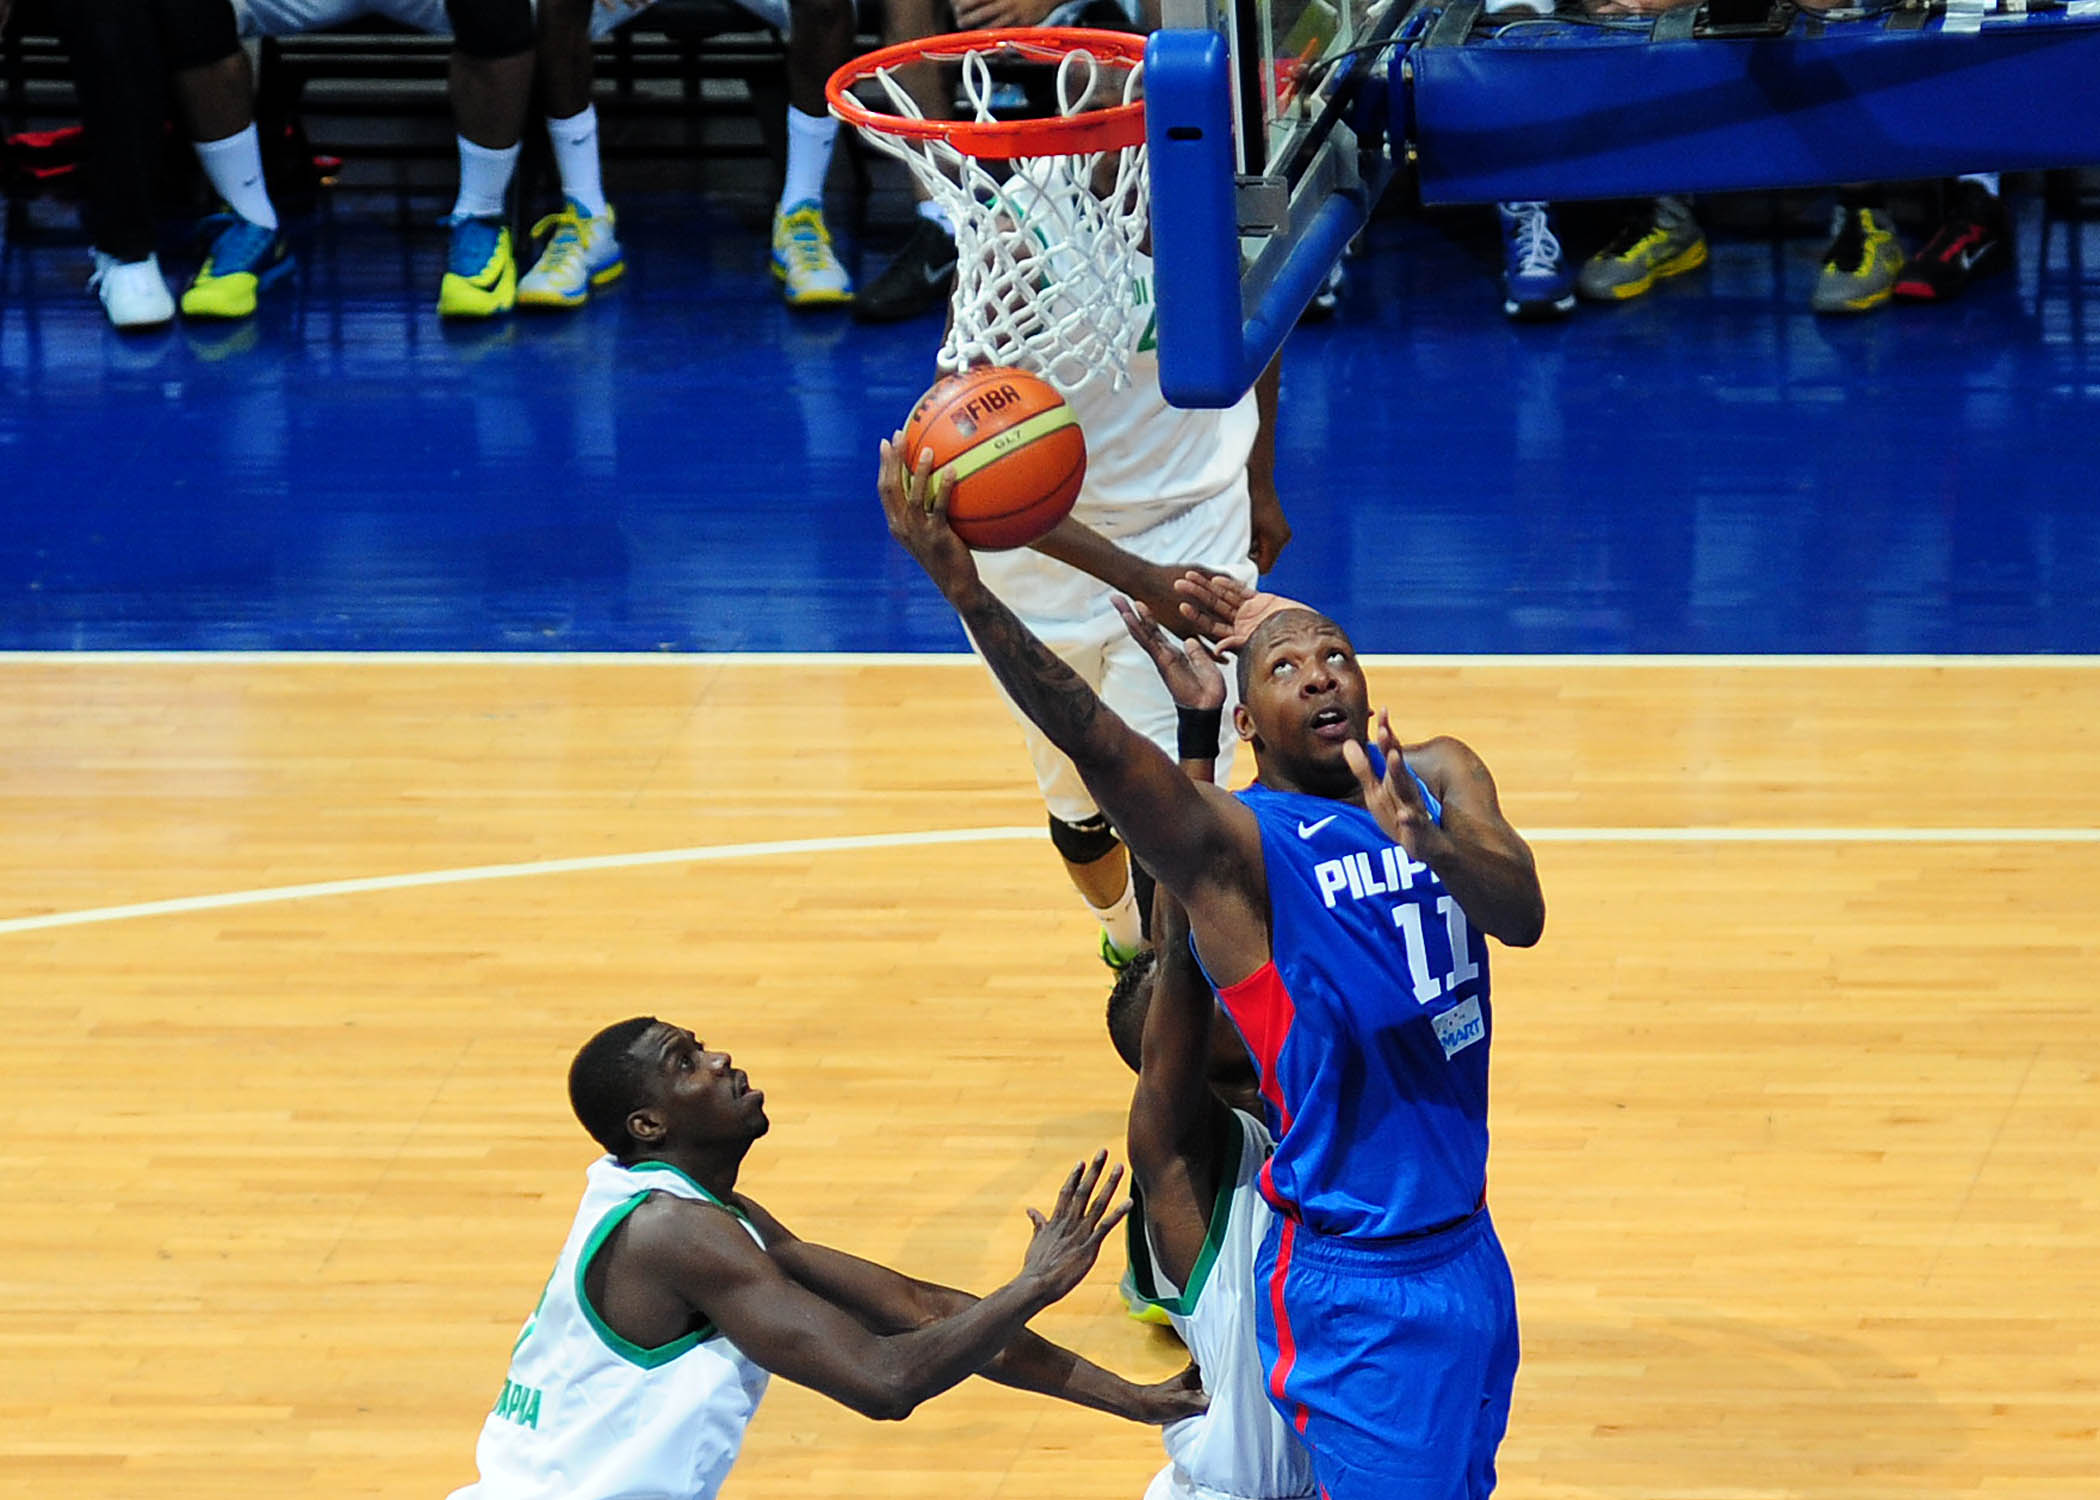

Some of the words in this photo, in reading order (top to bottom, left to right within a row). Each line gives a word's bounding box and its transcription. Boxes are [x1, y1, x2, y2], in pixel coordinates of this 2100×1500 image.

[966, 384, 1021, 420] FIBA
[1314, 846, 1440, 908] PILIP
[1391, 895, 1479, 1005] 11
